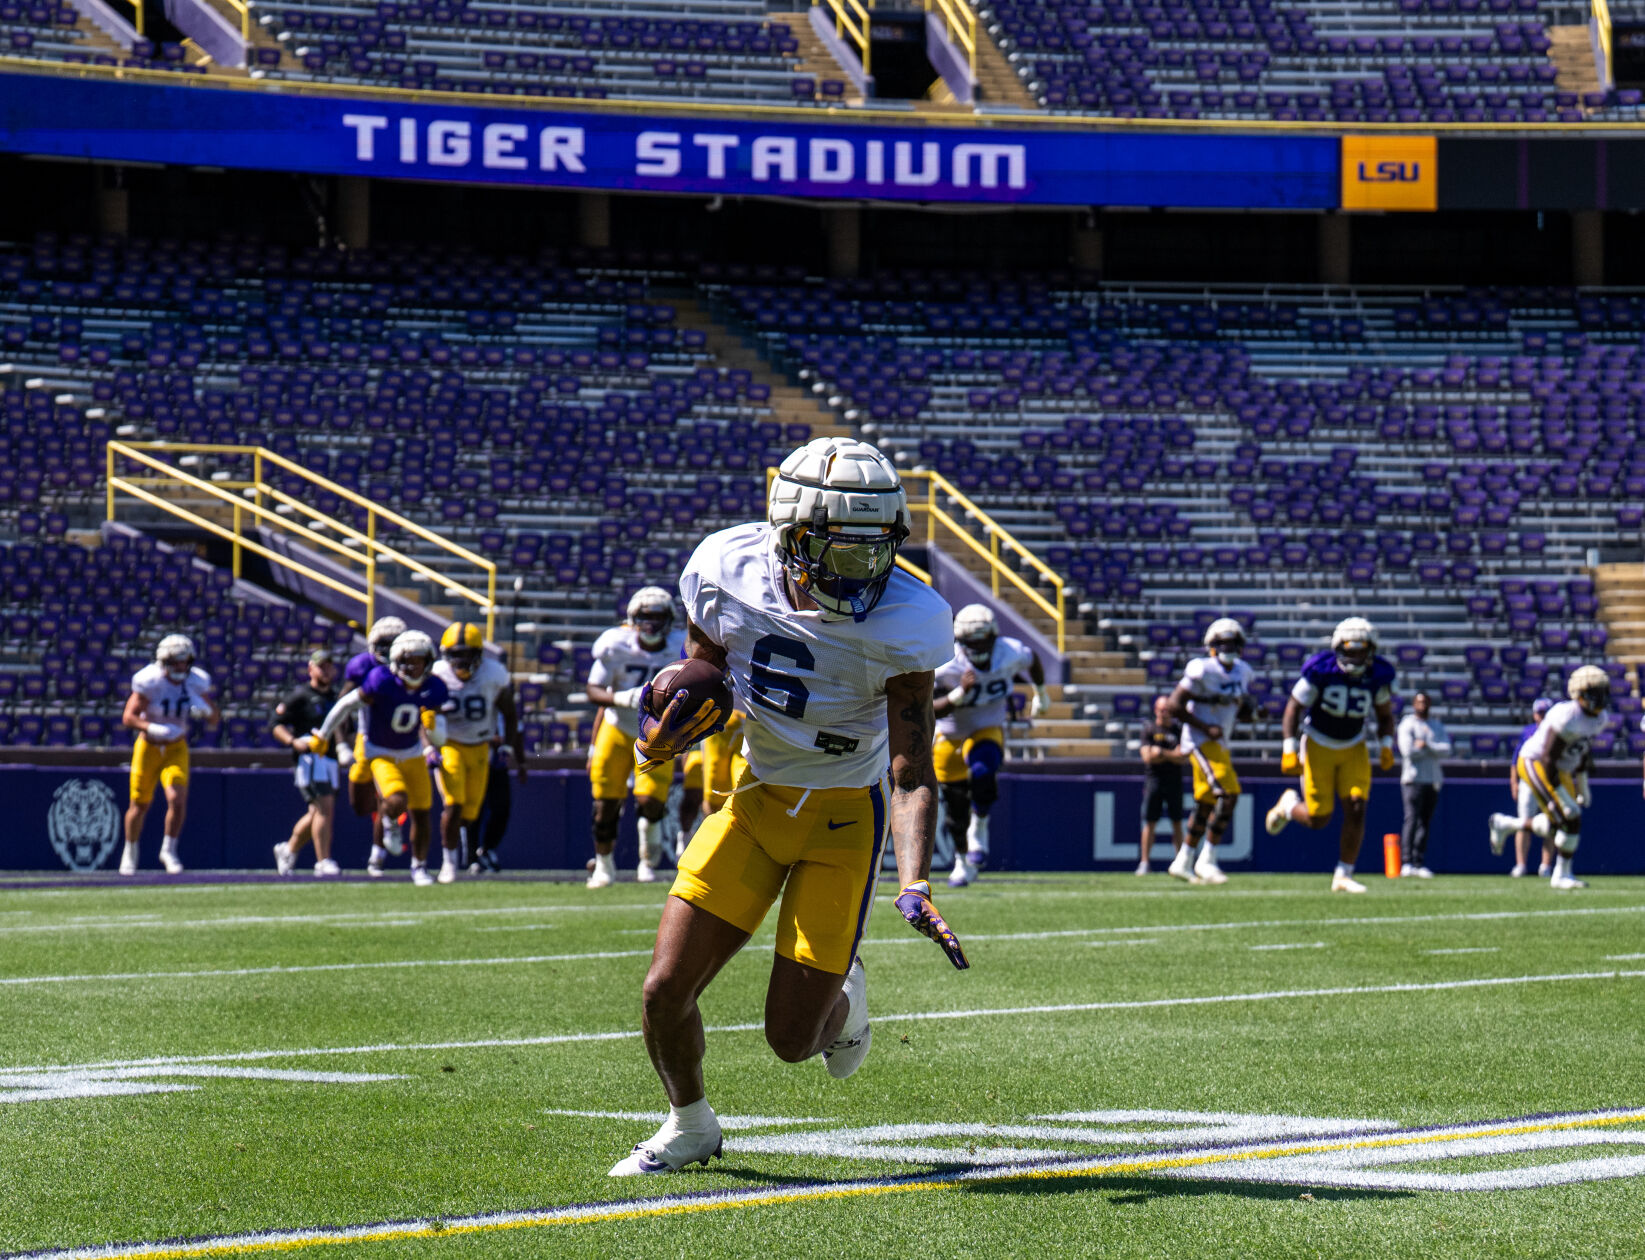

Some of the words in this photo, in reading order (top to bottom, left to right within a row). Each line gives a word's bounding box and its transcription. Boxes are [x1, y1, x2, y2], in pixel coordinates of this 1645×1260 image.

[342, 113, 586, 173] TIGER
[635, 131, 1027, 189] STADIUM
[1358, 161, 1420, 182] LSU
[748, 633, 815, 719] 6
[1320, 685, 1373, 718] 93
[391, 703, 420, 734] 0
